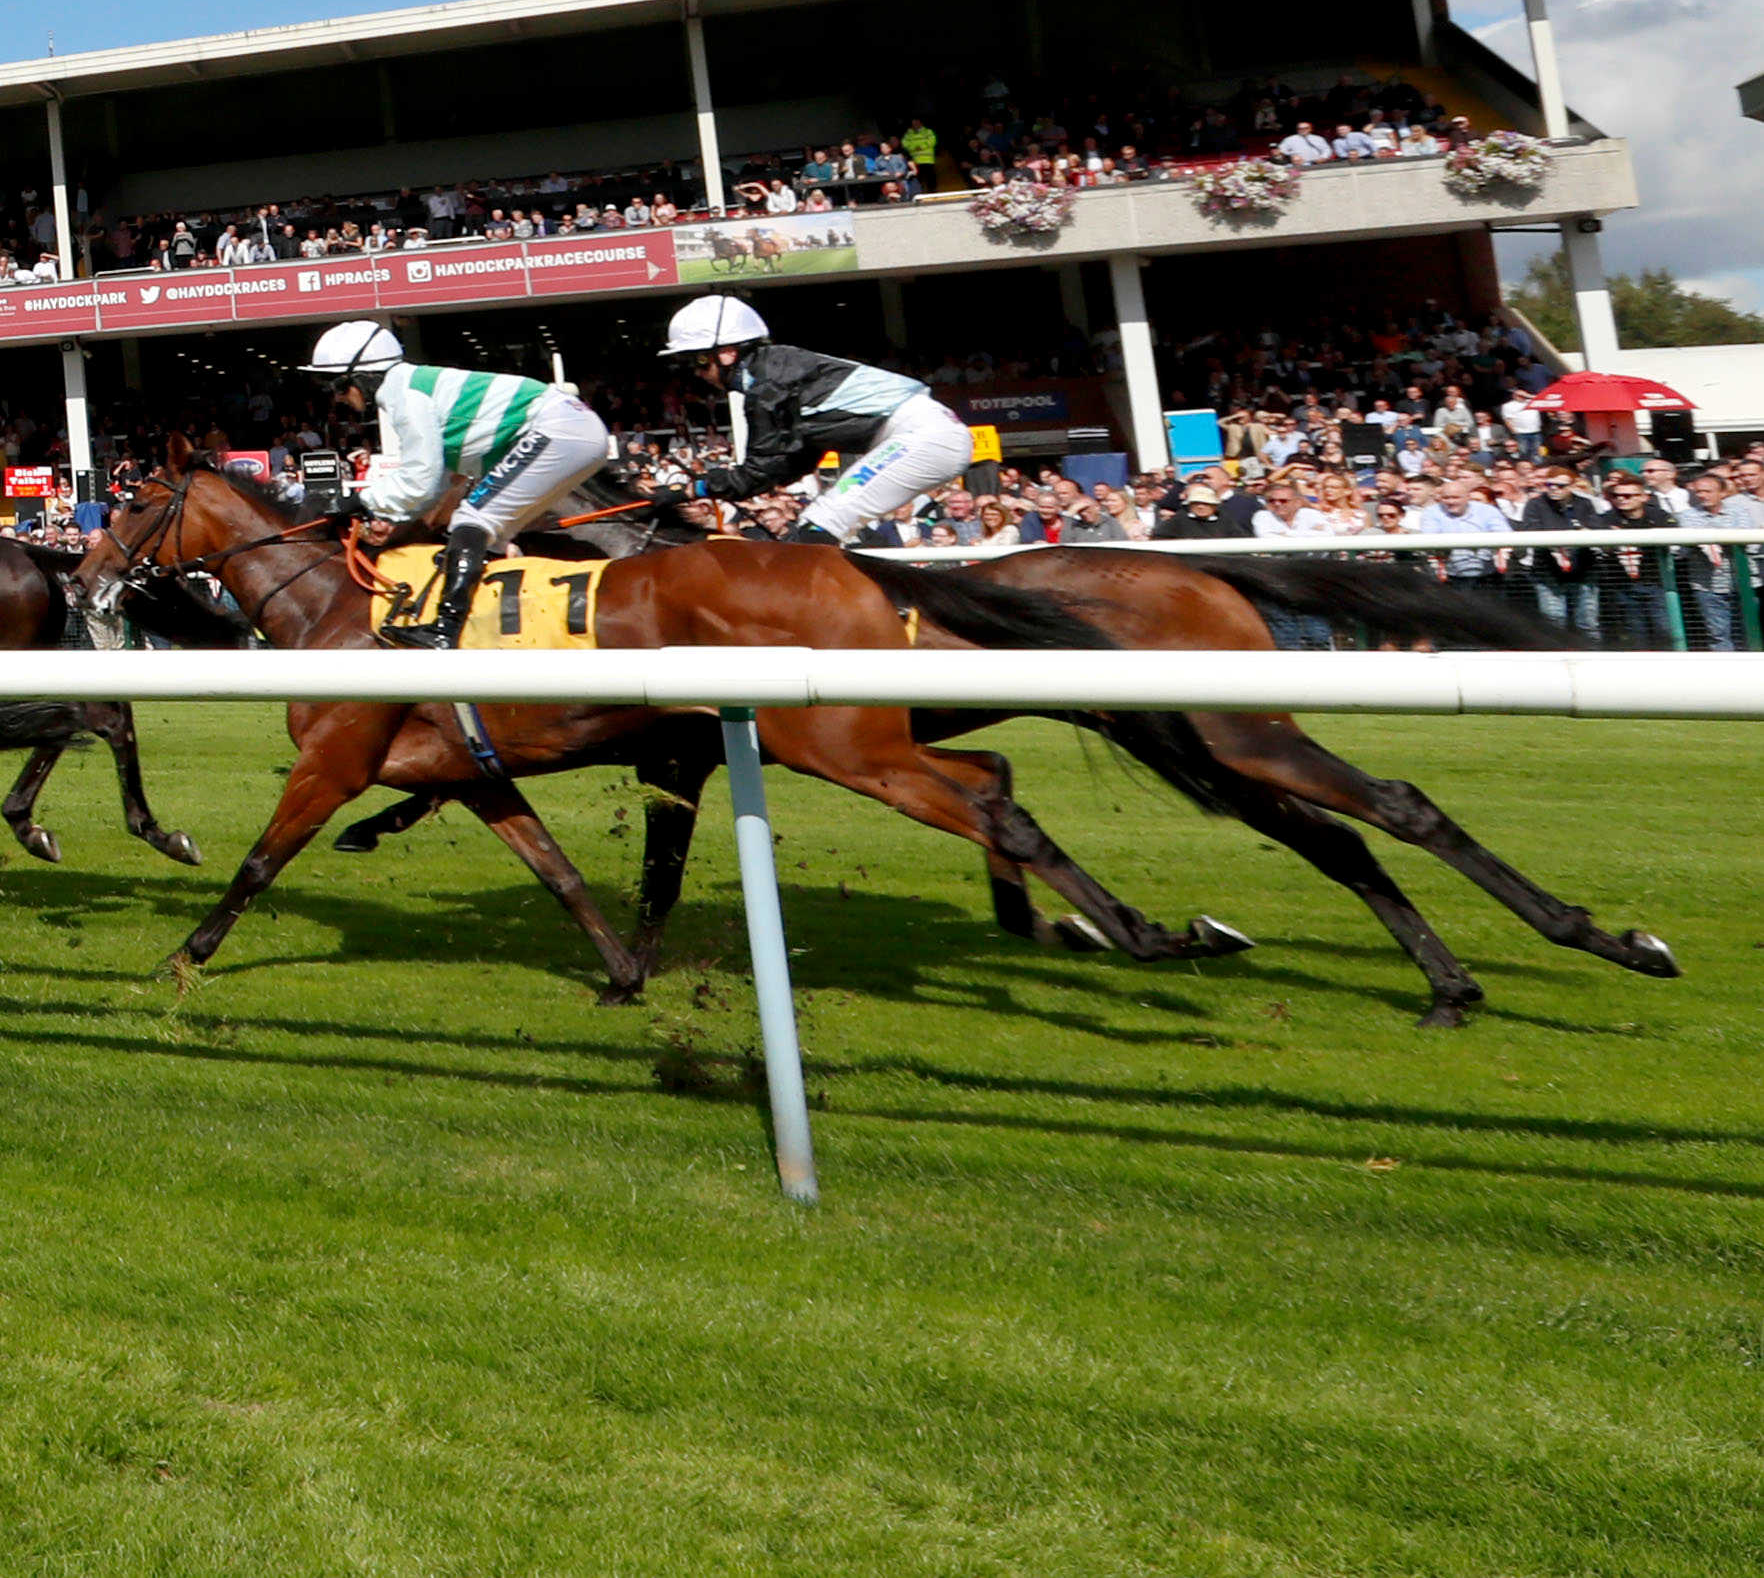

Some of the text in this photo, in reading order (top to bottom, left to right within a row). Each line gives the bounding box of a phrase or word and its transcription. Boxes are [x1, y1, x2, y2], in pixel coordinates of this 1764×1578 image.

[24, 245, 647, 312] #HAYDOCKPARK @HAYDOCKRACES HPRACES HAYDOCKPARKRACECOURSE
[970, 395, 1057, 410] TOTEPOOL
[482, 568, 591, 635] 11
